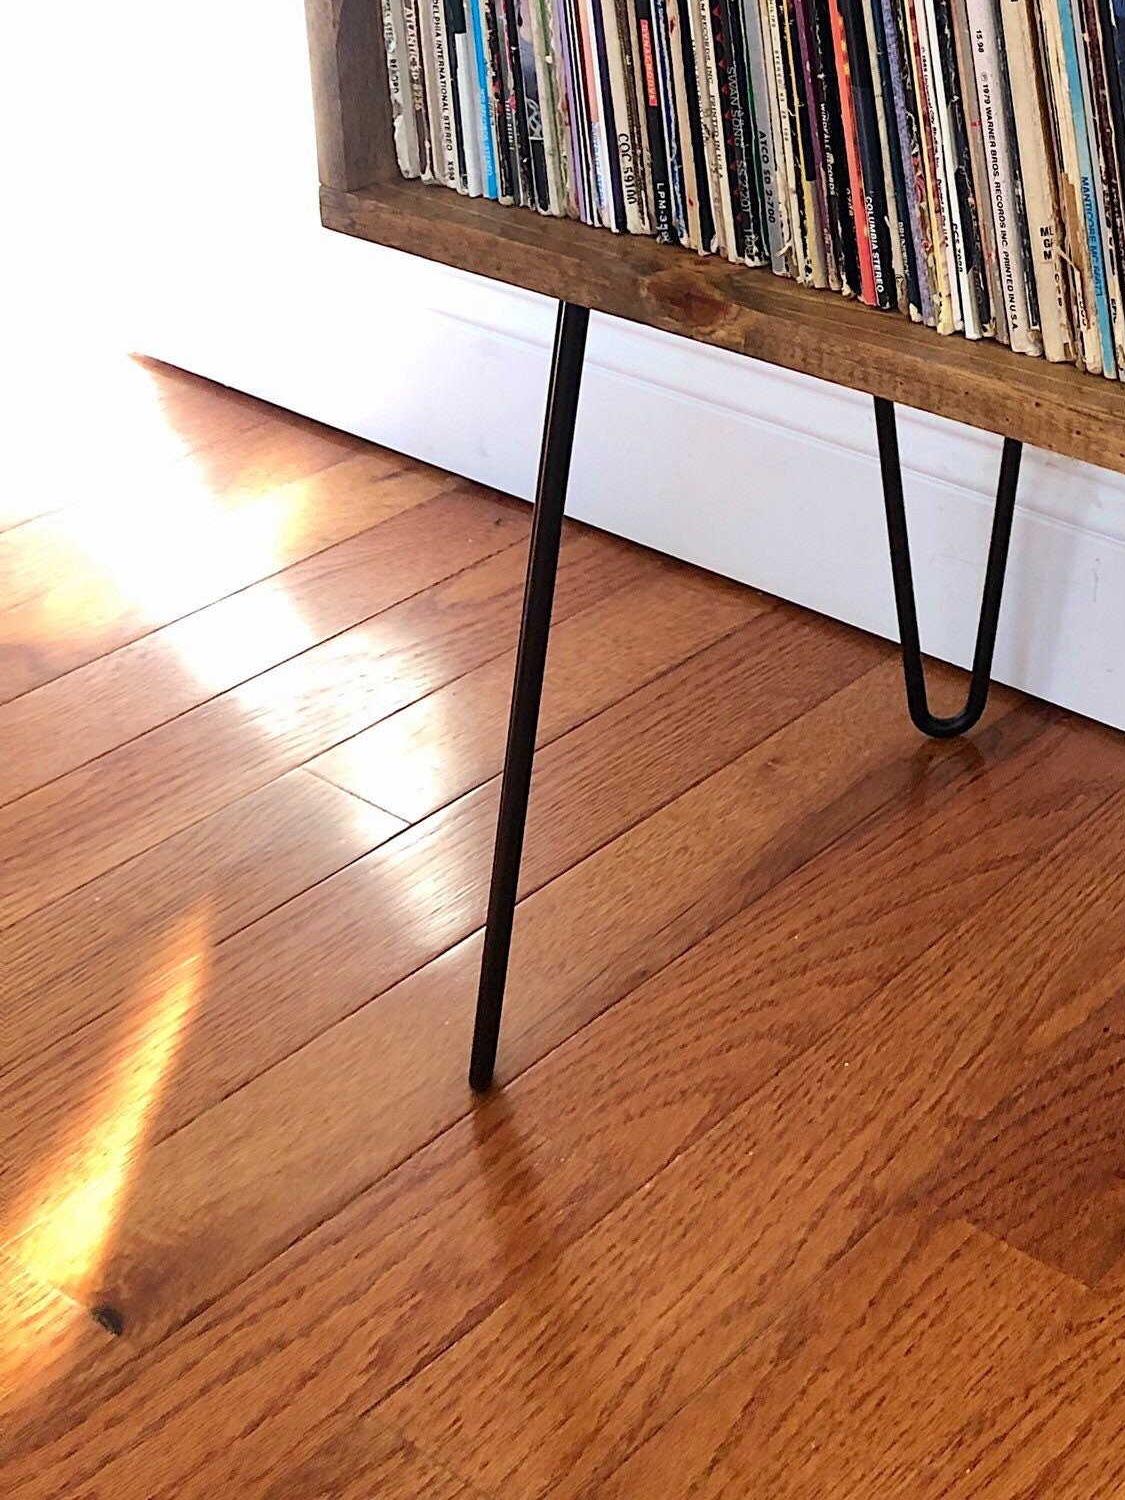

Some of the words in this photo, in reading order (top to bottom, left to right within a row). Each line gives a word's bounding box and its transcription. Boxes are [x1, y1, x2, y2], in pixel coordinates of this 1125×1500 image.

[435, 39, 450, 112] INTERNATIONAL
[443, 115, 453, 152] STEREO
[725, 66, 739, 107] SWAN
[982, 84, 992, 105] 1979
[730, 109, 744, 147] SONG
[759, 130, 770, 164] ATCO
[985, 106, 997, 148] WARNER
[624, 167, 638, 205] 59100
[763, 168, 773, 185] SD
[765, 189, 777, 224] 2-700
[866, 196, 879, 250] COLUMBIA
[994, 181, 1007, 230] RECORDS
[1081, 176, 1097, 243] MANTICORE
[872, 253, 884, 293] STEREO
[1002, 250, 1014, 292] PRINTED
